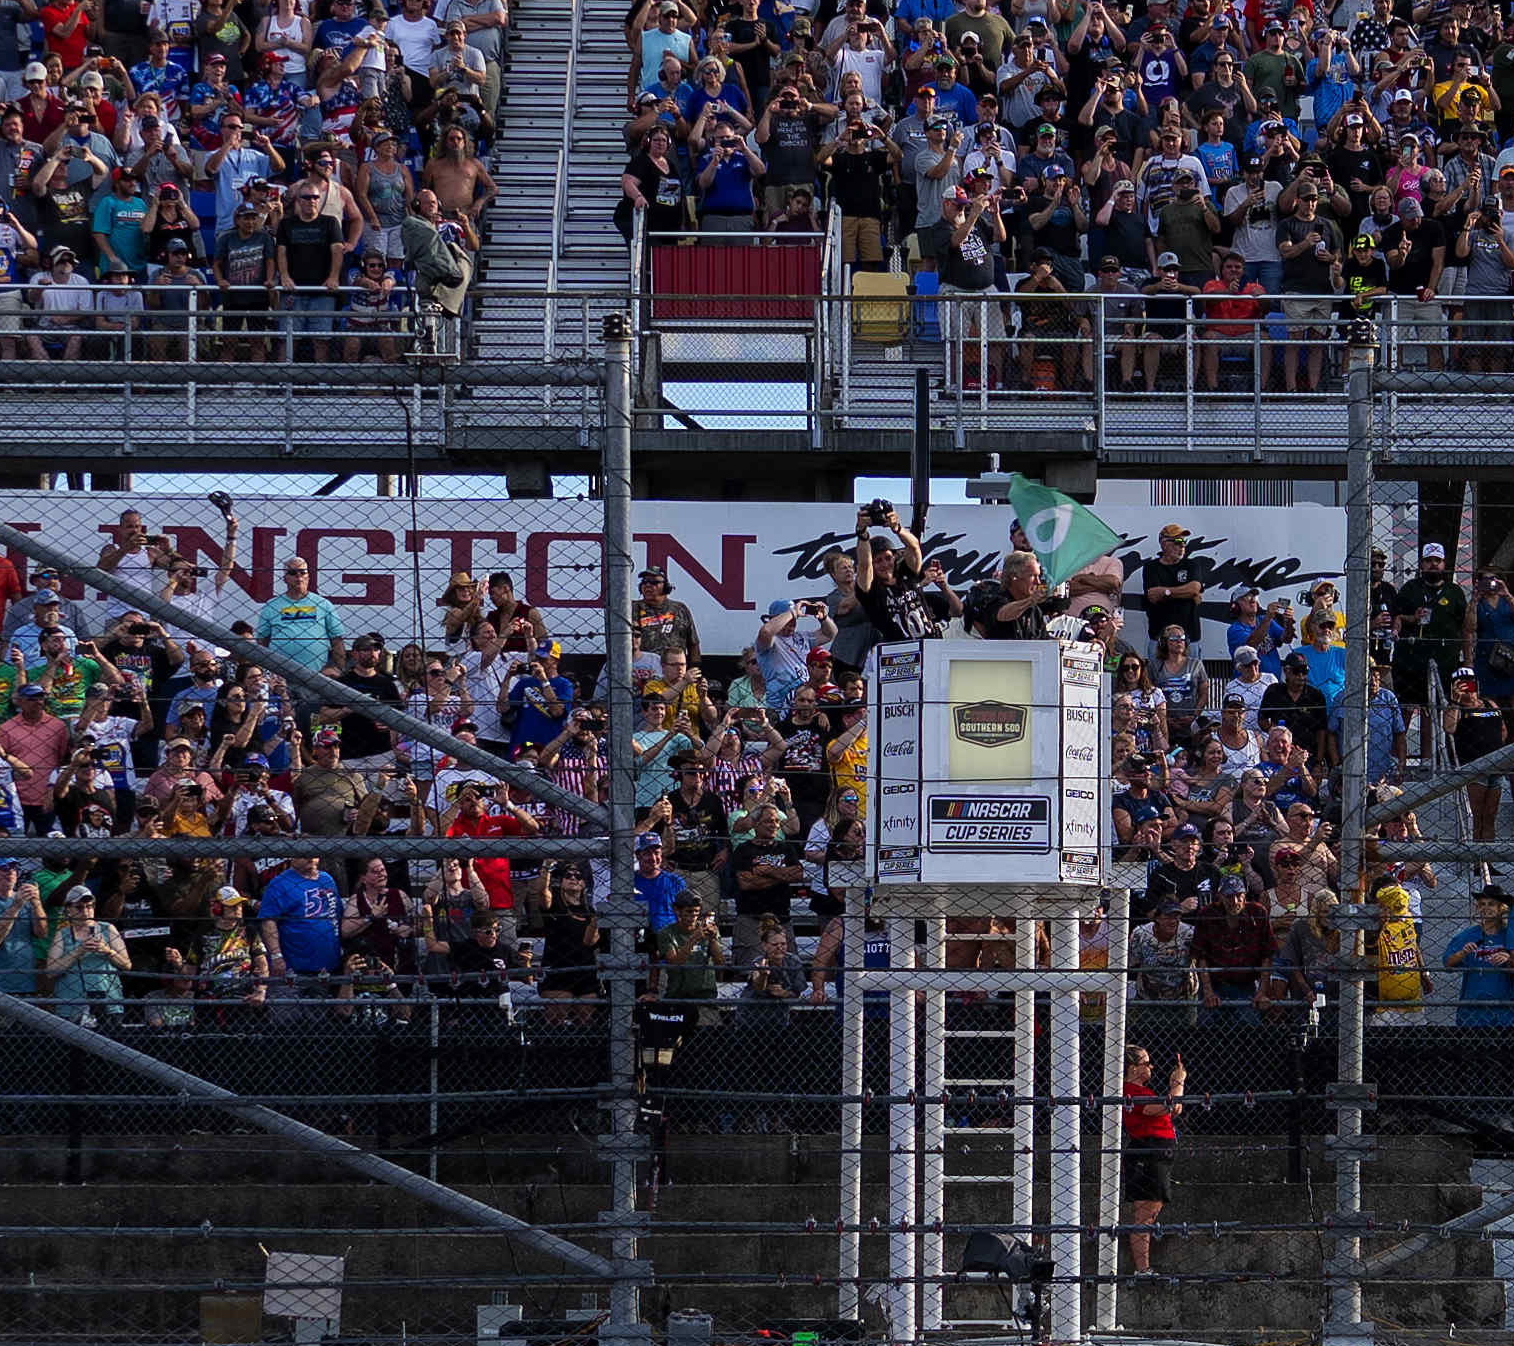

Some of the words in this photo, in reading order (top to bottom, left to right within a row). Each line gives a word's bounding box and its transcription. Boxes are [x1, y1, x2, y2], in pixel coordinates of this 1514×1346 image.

[1350, 276, 1362, 287] 12
[661, 623, 673, 633] 19
[885, 704, 914, 719] BUSCH
[1066, 709, 1093, 724] BUSCH
[960, 722, 1003, 733] SOUTHERN
[1004, 723, 1020, 733] 500
[883, 784, 915, 795] GEICO
[1066, 789, 1094, 800] GEICO
[967, 802, 1032, 818] NASCAR
[883, 816, 916, 831] xfinity
[1065, 819, 1095, 838] xfinity
[945, 826, 977, 840] CUP
[978, 826, 1032, 840] SERIES
[1197, 878, 1212, 891] 4
[649, 1013, 684, 1023] WHELEN
